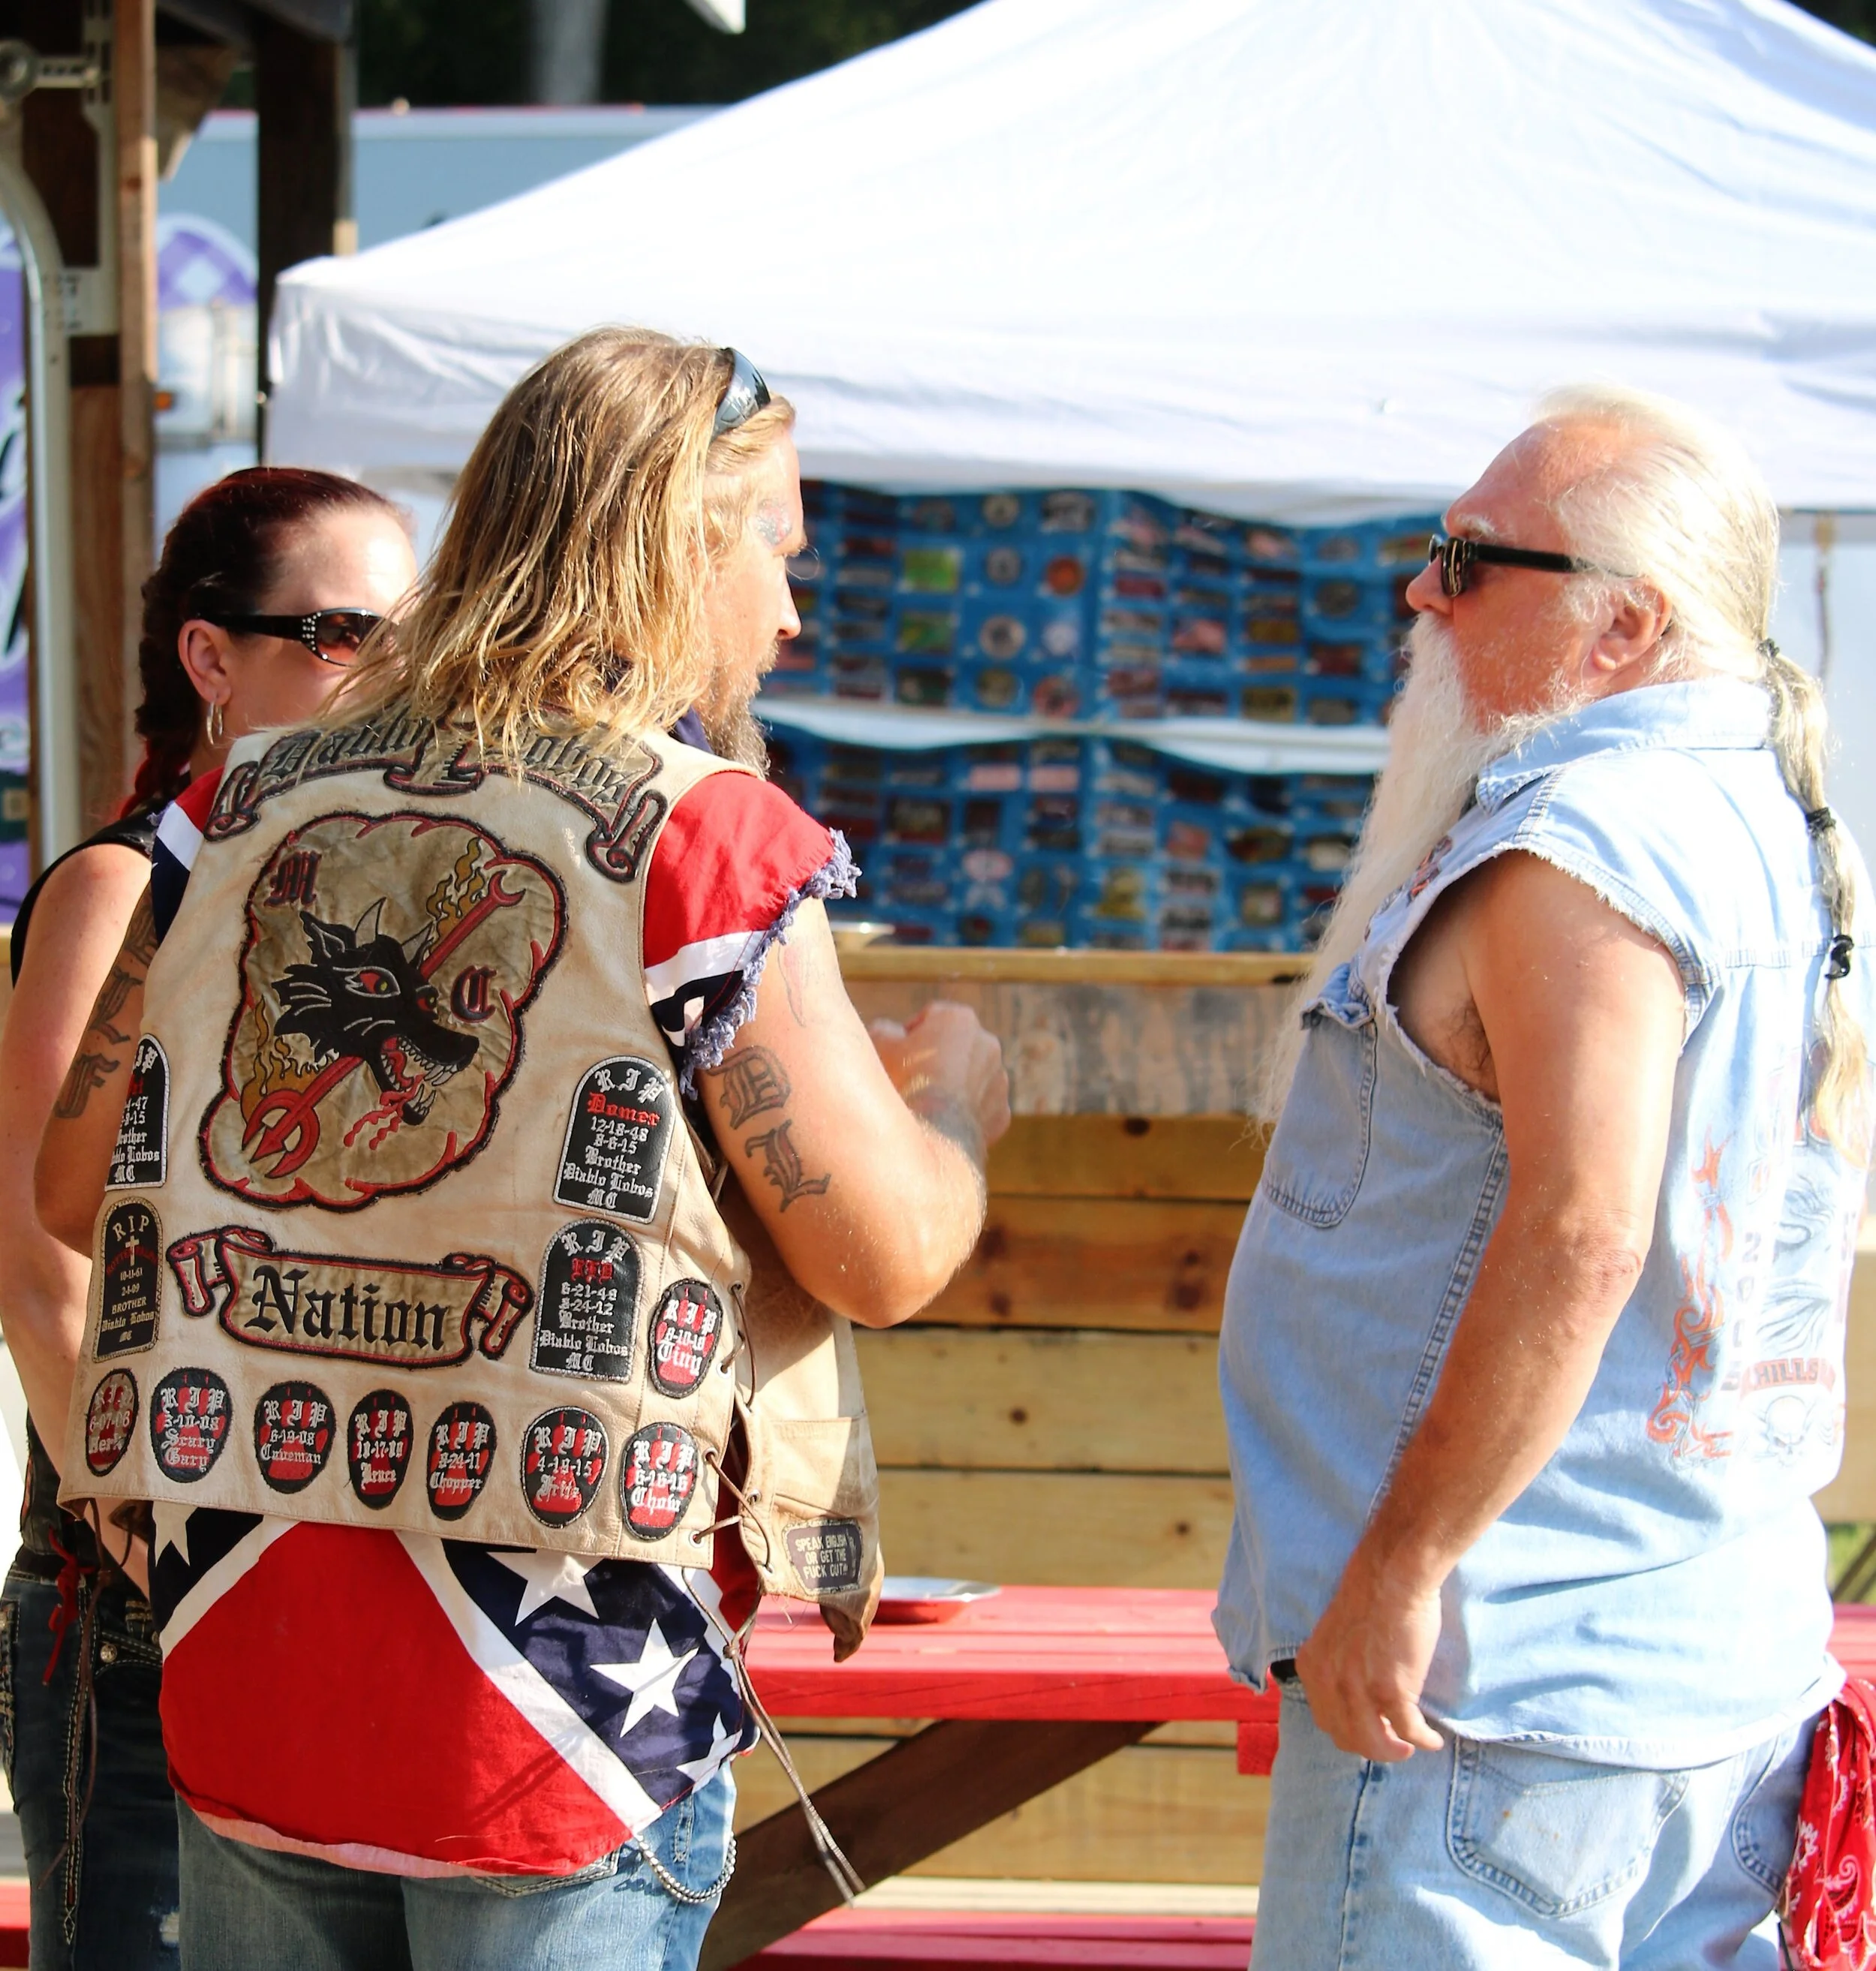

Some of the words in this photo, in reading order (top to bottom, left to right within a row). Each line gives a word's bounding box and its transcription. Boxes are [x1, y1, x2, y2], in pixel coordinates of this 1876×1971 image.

[452, 965, 497, 1022] C
[134, 1045, 158, 1074] IP
[127, 1145, 161, 1163] Lobos
[585, 1145, 642, 1175] Brother
[563, 1161, 606, 1187] Diablo
[610, 1172, 654, 1199] Lobos
[587, 1188, 618, 1209] MC
[112, 1296, 147, 1315] BROTHER
[244, 1264, 449, 1352] Nation
[101, 1316, 127, 1333] Diablo
[130, 1310, 155, 1326] Lobos
[558, 1310, 615, 1335] Brother
[539, 1329, 582, 1350] Diablo
[585, 1335, 629, 1358] Lobos
[565, 1352, 594, 1372] MC
[657, 1339, 704, 1377] Tiny
[161, 1428, 216, 1455] Scary
[260, 1443, 322, 1464] Caveman
[164, 1446, 210, 1473] Gary
[429, 1471, 483, 1494] Chopper
[795, 1536, 824, 1552] SPEAK
[804, 1551, 819, 1566] OR
[820, 1549, 834, 1563] GET
[802, 1563, 828, 1580] FUCK
